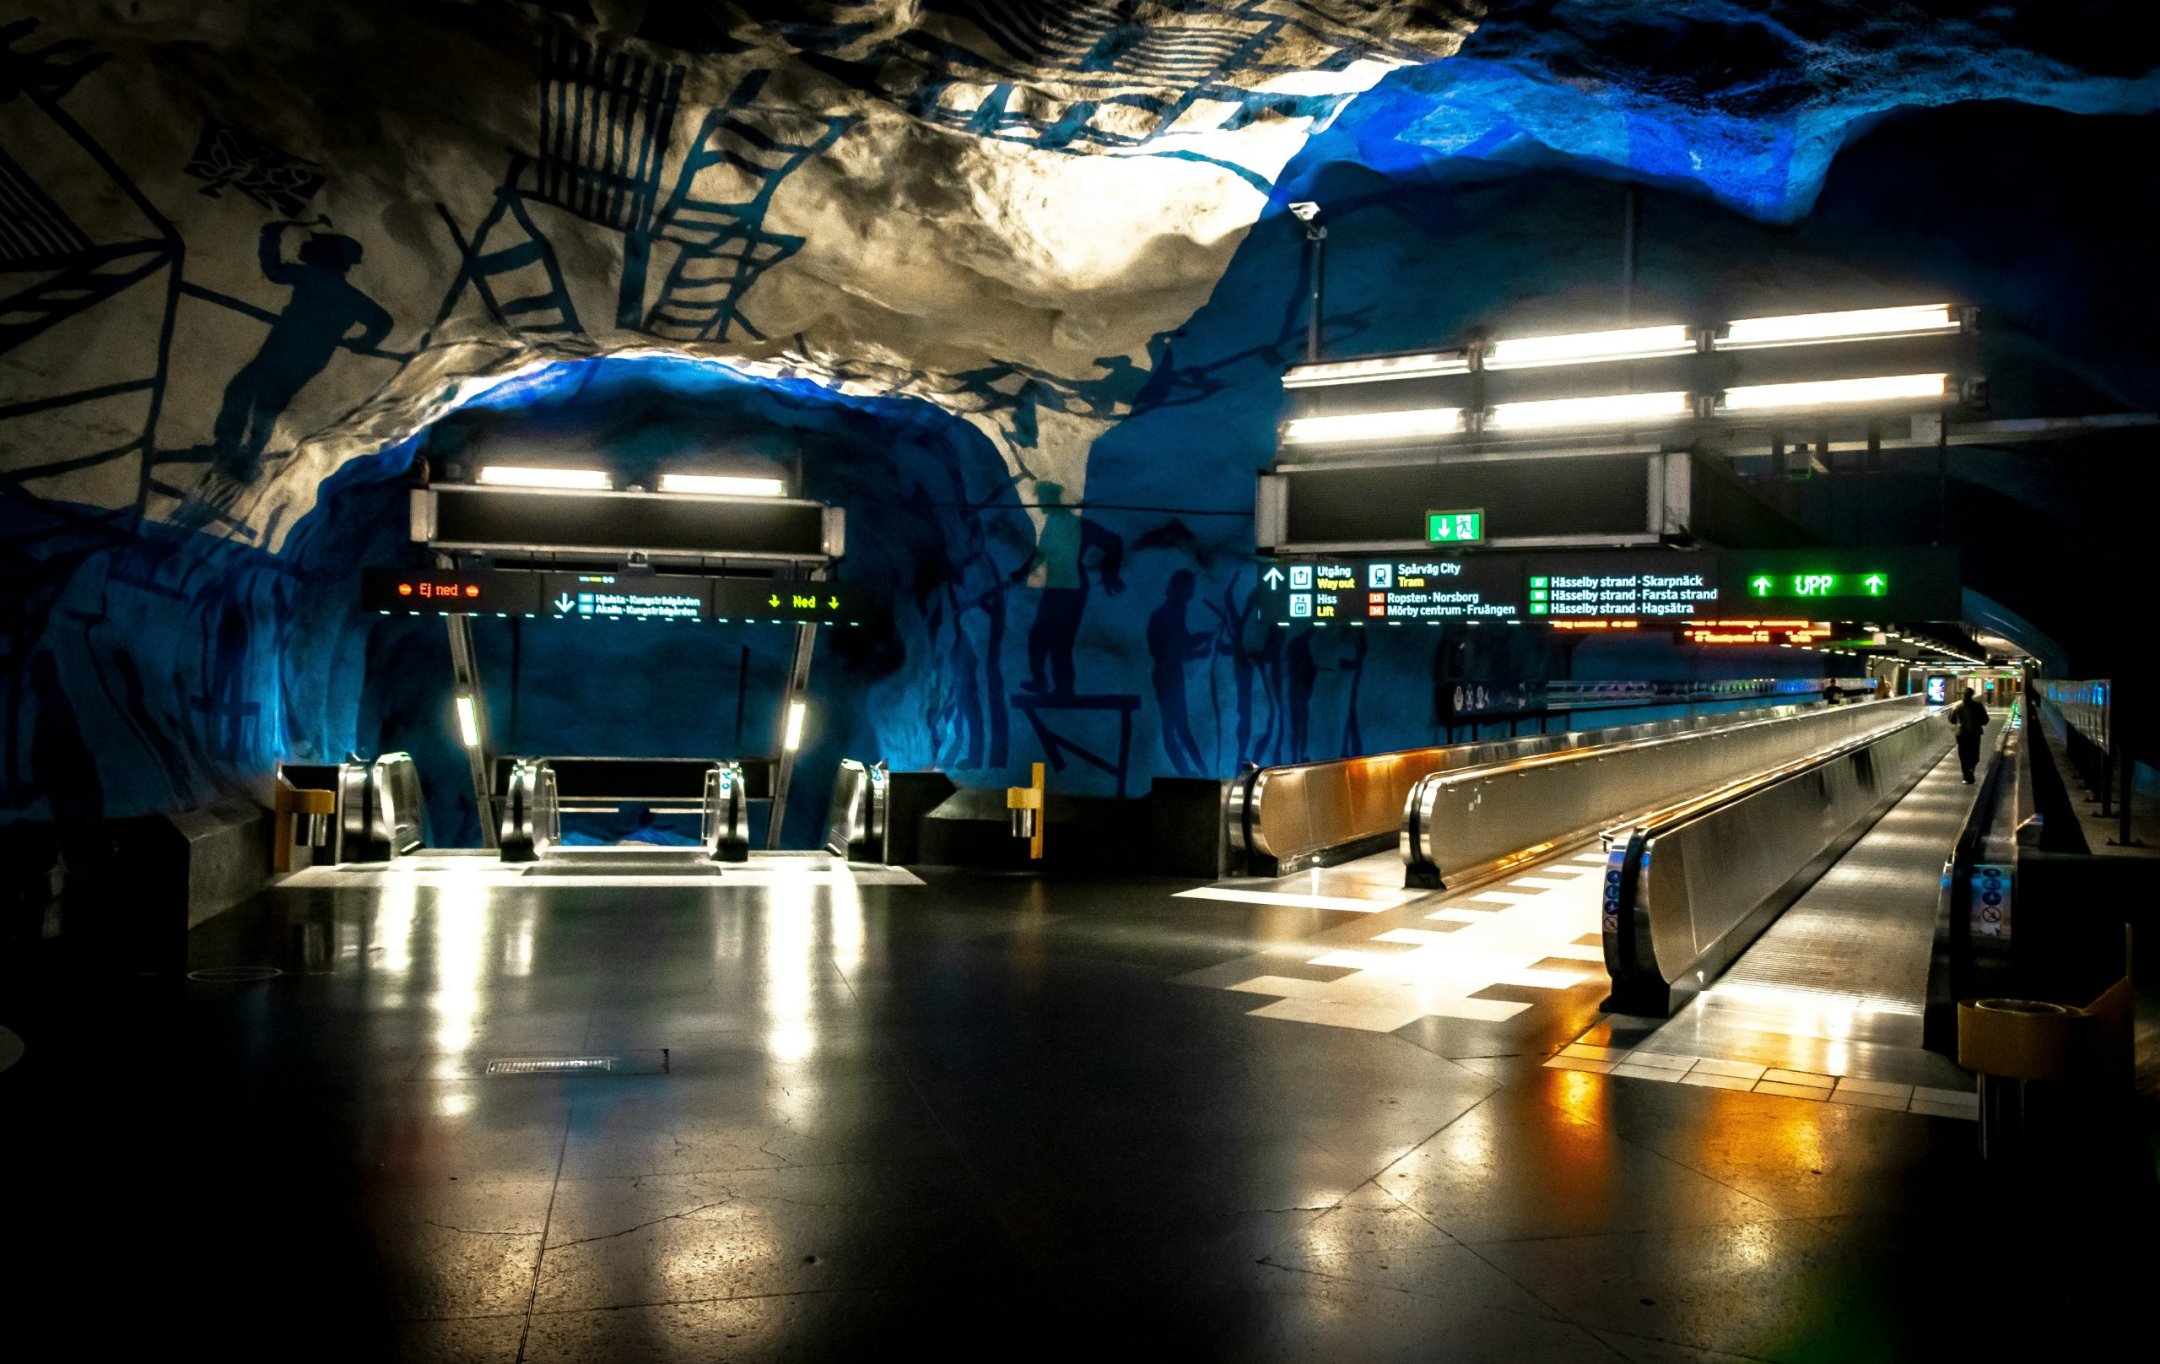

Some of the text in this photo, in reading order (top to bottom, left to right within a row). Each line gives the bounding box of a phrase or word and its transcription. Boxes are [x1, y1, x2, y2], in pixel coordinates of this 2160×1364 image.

[1317, 565, 1352, 578] Utgång
[1398, 563, 1461, 576] Spårväg City
[1317, 578, 1355, 590] Way out
[1398, 577, 1425, 587] Tram
[1551, 576, 1599, 589] Hässelby
[1600, 576, 1636, 587] strand
[1642, 575, 1704, 589] Skarpnäck
[1795, 575, 1833, 595] UPP
[419, 582, 458, 598] Ej ned
[1551, 590, 1599, 602] Hässelby
[1600, 590, 1636, 601] strand
[1642, 589, 1678, 600] Farsta
[1680, 588, 1718, 600] strand
[793, 595, 816, 608] Ned
[1317, 594, 1337, 604] Hiss
[1387, 592, 1427, 603] Ropsten
[1433, 591, 1479, 603] Norsborg
[1317, 606, 1334, 617] Lift
[1387, 605, 1418, 617] Mörby
[1420, 606, 1461, 615] centrum
[1467, 604, 1516, 617] Fruängen
[1551, 603, 1599, 615] Hässelby
[1600, 603, 1636, 614] strand
[1642, 602, 1694, 616] Hagsätra
